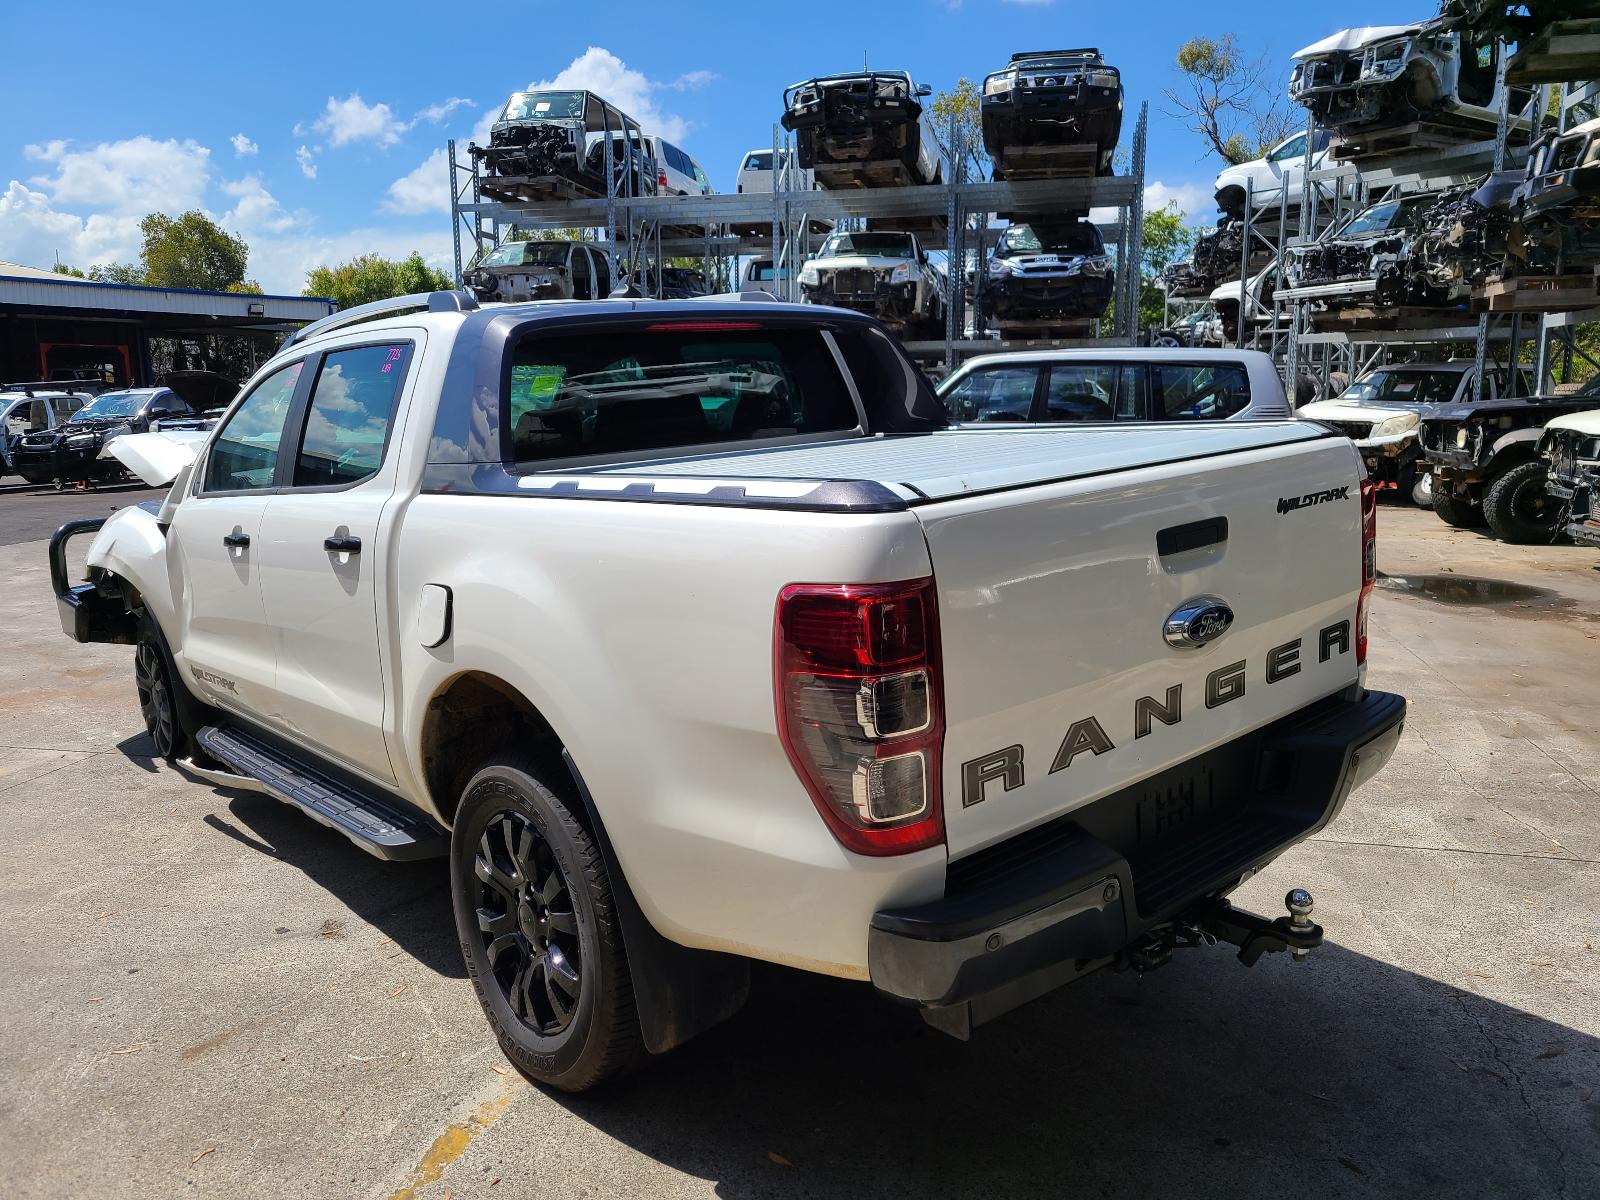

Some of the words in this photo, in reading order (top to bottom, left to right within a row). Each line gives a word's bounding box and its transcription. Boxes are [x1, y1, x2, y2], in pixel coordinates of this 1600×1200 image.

[1277, 485, 1350, 515] WILDTRAK
[1199, 611, 1227, 637] Ford
[191, 664, 239, 695] WILDTRAK
[962, 619, 1351, 808] RANGER
